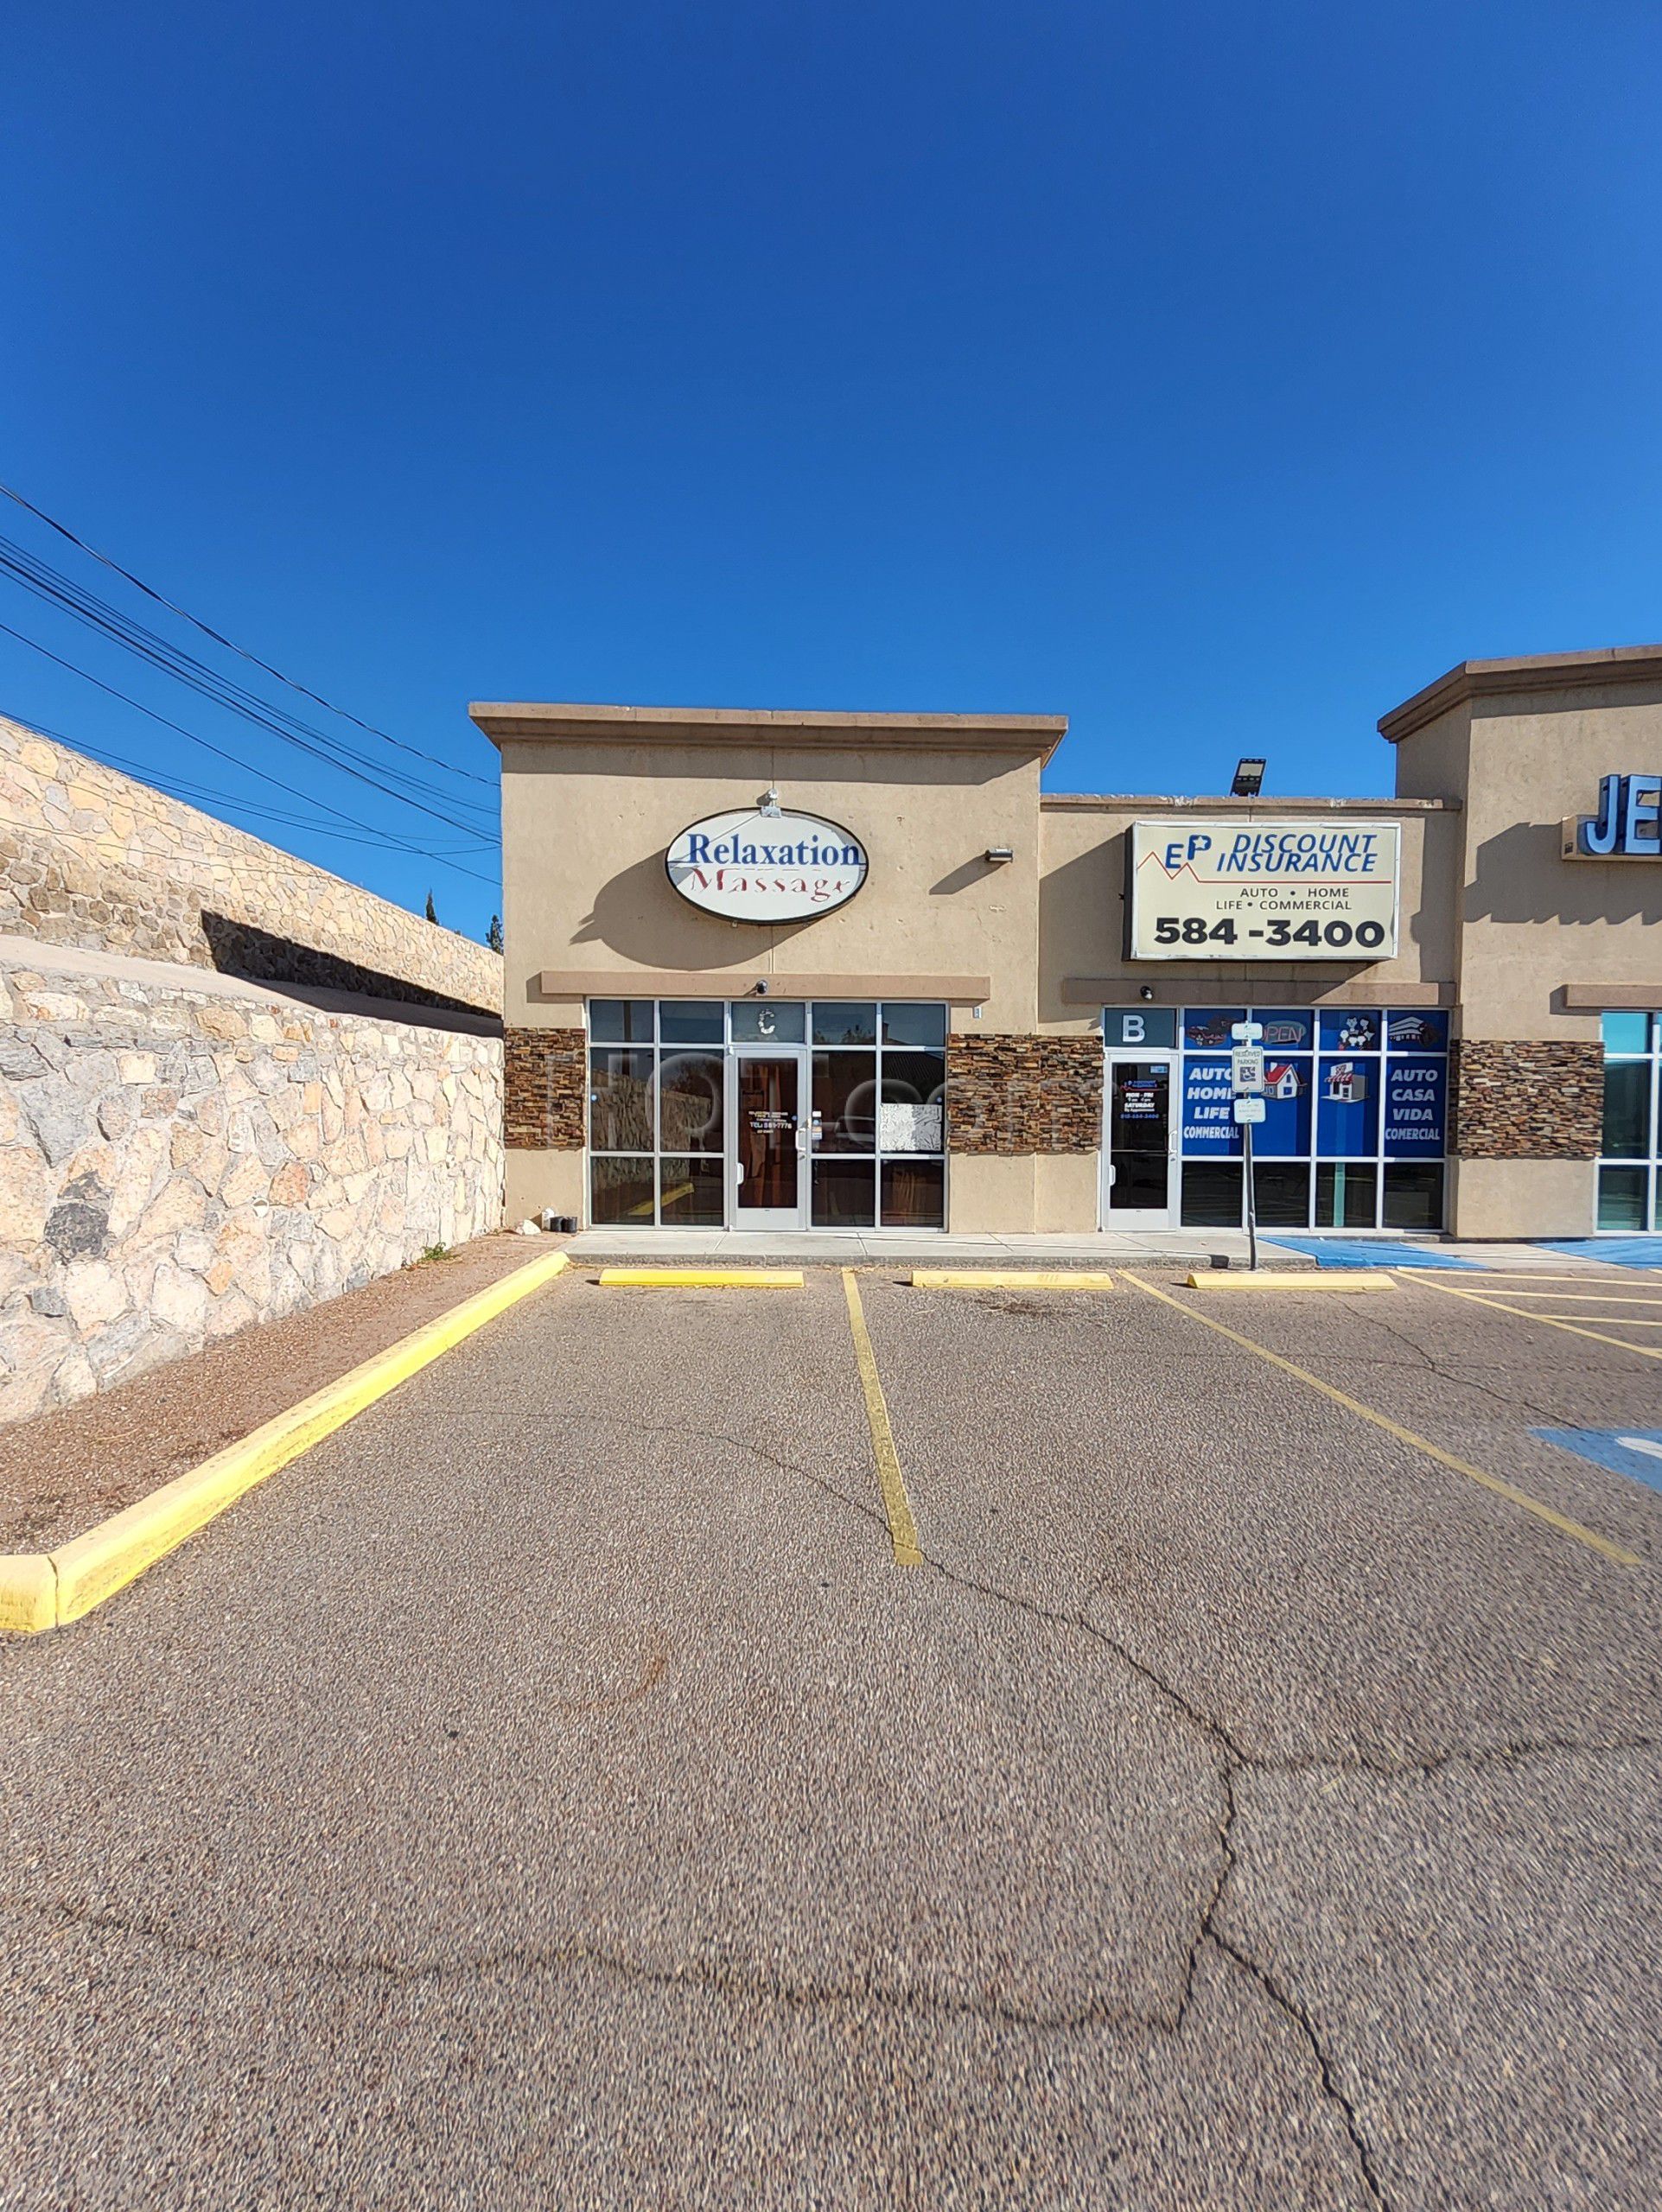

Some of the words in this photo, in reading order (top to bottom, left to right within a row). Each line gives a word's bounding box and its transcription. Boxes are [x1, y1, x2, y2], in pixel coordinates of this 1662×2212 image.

[688, 834, 860, 866] Relaxation
[1233, 834, 1378, 853] DISCOUNT
[1166, 835, 1212, 869] EP
[1217, 853, 1376, 872] INSURANCE
[1240, 887, 1278, 898] AUTO
[1308, 887, 1349, 898] HOME
[1216, 900, 1242, 910] LIFE
[1259, 900, 1352, 910] COMMERCIAL
[1154, 918, 1238, 945] 584
[758, 1009, 775, 1034] C
[1122, 1014, 1146, 1042] B
[1391, 1069, 1438, 1082] AUTO
[1391, 1089, 1436, 1102] CASA
[1194, 1107, 1231, 1120] LIFE
[1392, 1109, 1434, 1121] VIDA
[1183, 1126, 1239, 1139] COMMERCIAL
[1385, 1128, 1441, 1141] COMERCIAL
